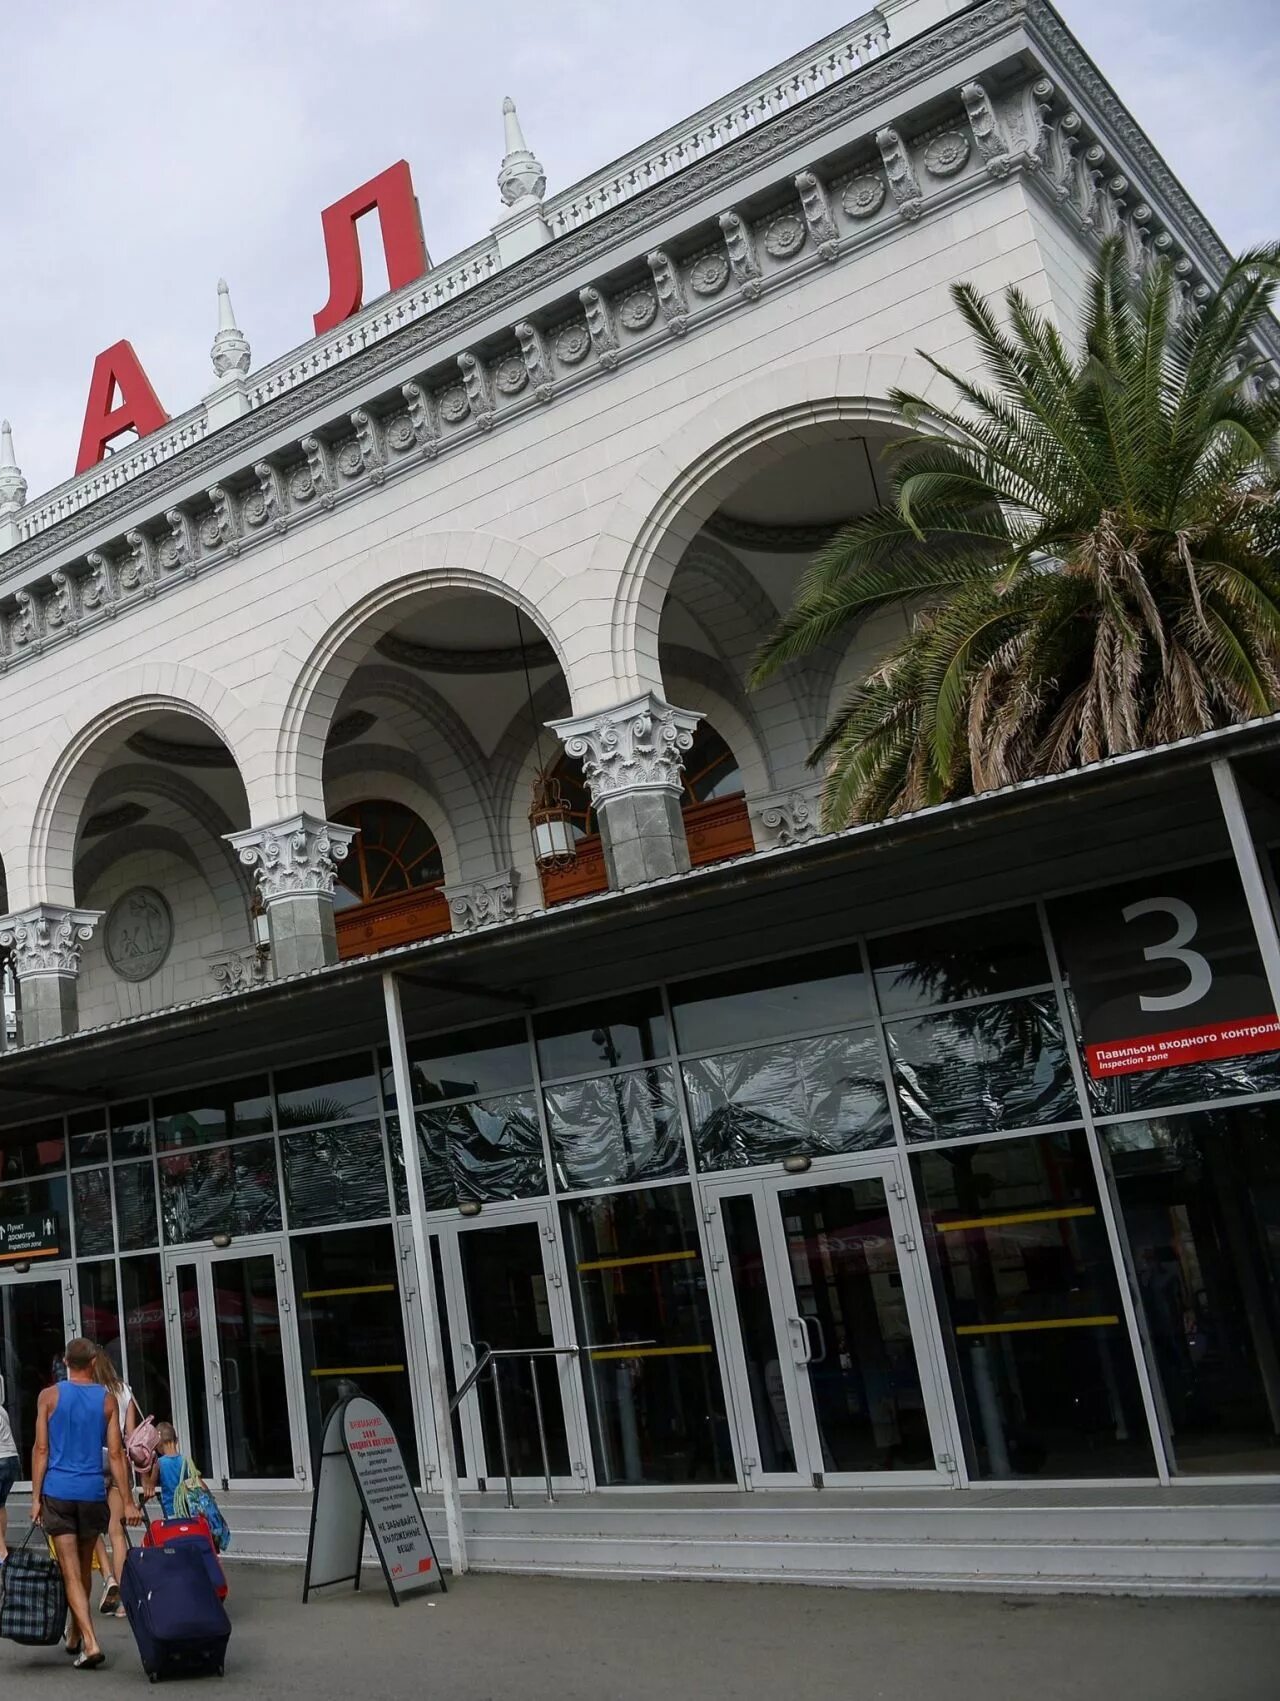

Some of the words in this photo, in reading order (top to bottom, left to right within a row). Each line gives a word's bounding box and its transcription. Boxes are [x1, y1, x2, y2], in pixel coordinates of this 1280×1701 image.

[1122, 896, 1213, 1012] 3
[1096, 1043, 1156, 1061] Павильон
[1159, 1033, 1218, 1050] входного
[1221, 1022, 1280, 1040] контроля
[1099, 1056, 1144, 1070] Inspection
[1147, 1052, 1169, 1063] zone
[7, 1223, 25, 1232] Пункт
[7, 1231, 36, 1242] досмотра
